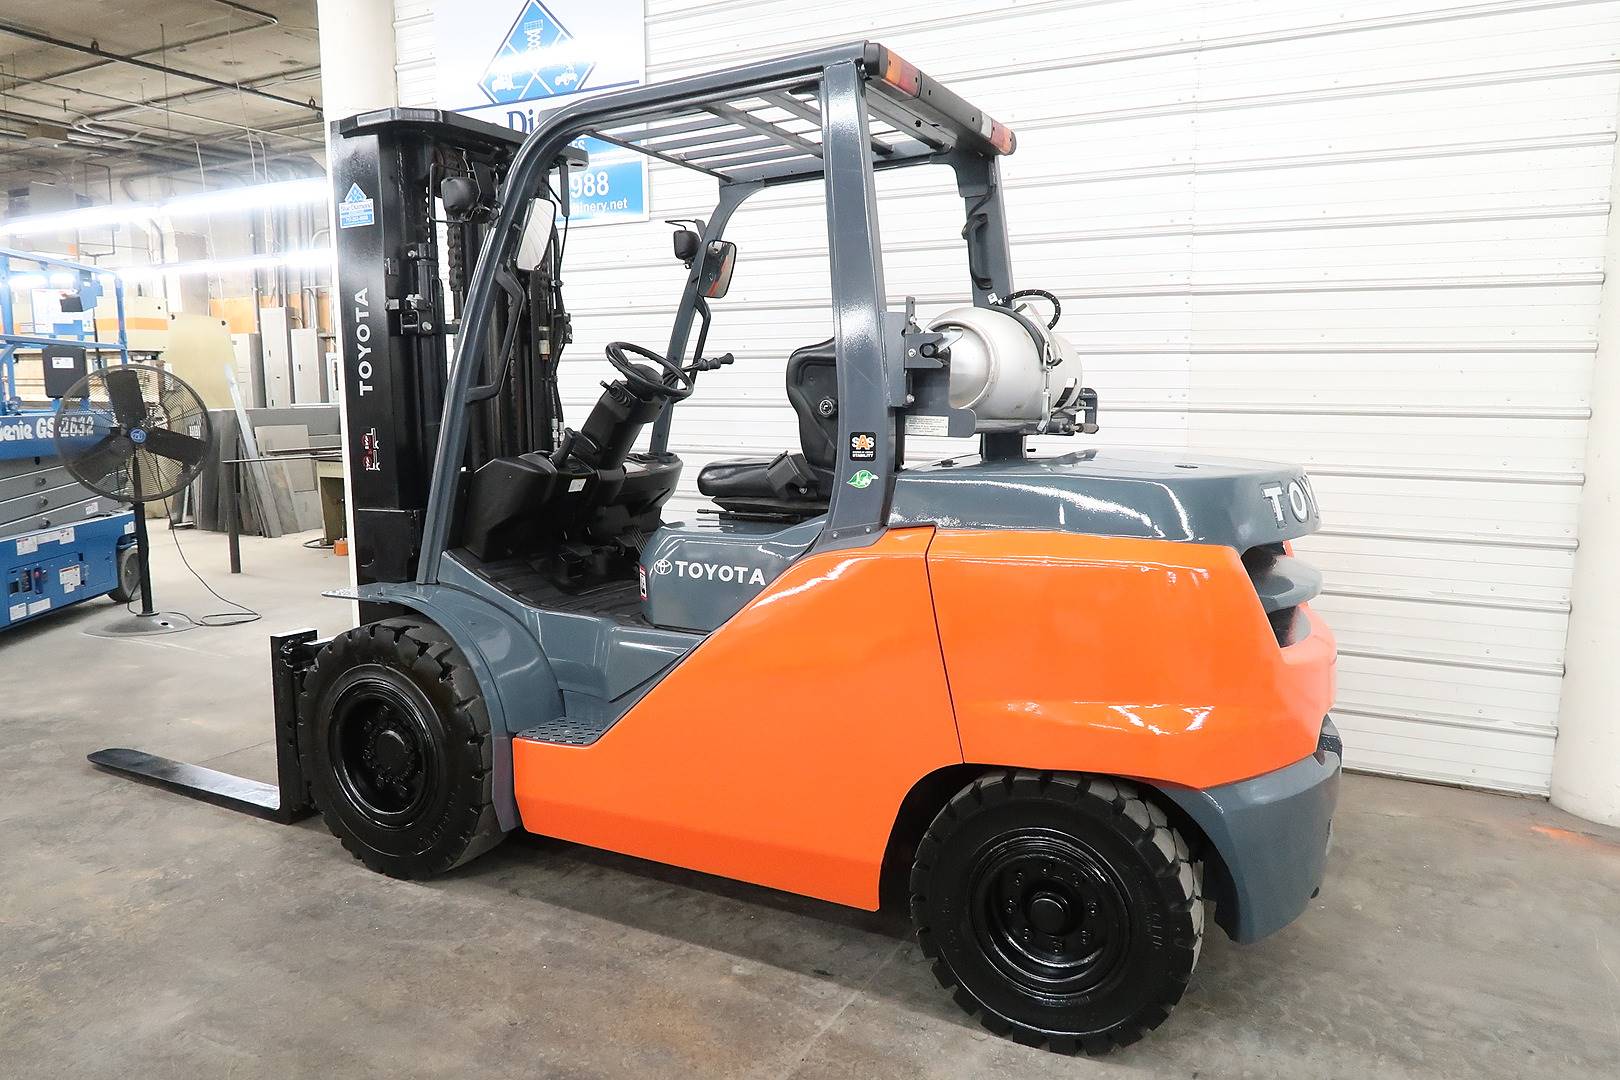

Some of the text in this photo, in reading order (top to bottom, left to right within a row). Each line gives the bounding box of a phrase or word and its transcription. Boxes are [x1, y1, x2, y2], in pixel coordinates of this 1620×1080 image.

[354, 287, 374, 397] TOYOTA
[0, 419, 33, 441] enie
[851, 434, 875, 450] SAS
[675, 560, 766, 586] TOYOTA
